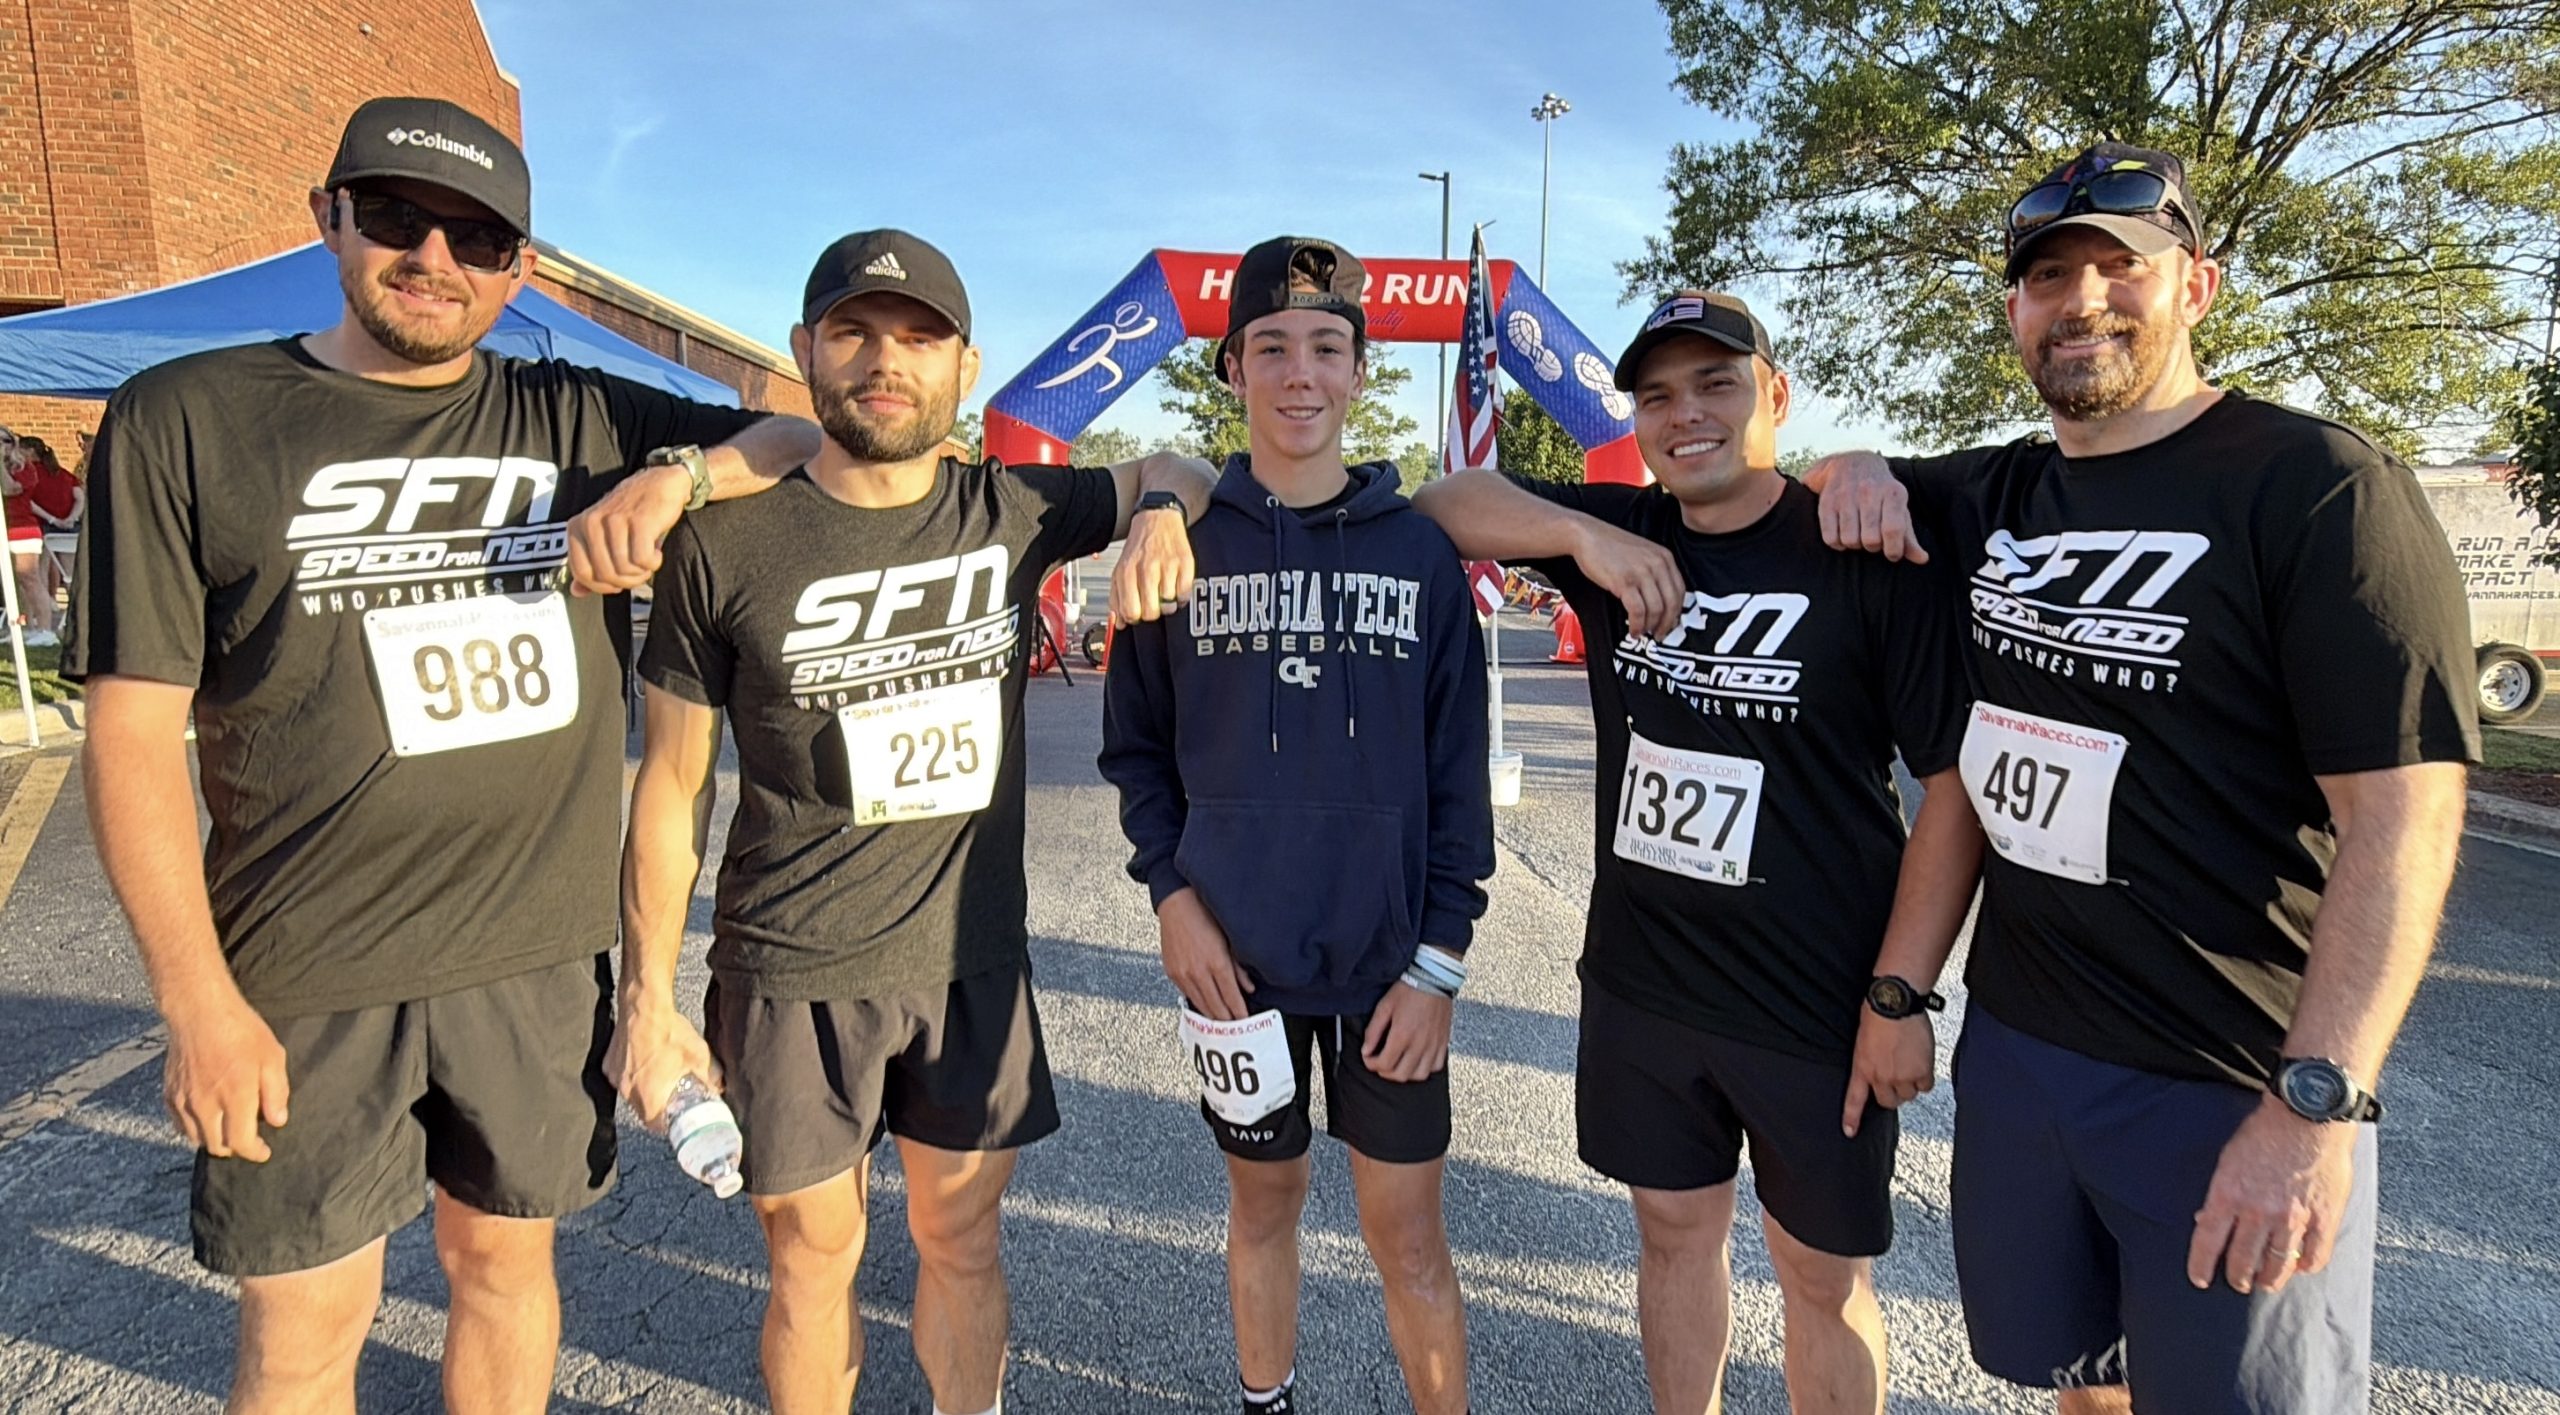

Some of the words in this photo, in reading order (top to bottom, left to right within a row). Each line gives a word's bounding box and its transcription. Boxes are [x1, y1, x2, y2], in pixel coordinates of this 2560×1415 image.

[408, 129, 493, 171] Columbia
[865, 265, 906, 280] adidas
[1381, 273, 1470, 306] RUN
[286, 457, 558, 539] SFN
[297, 543, 447, 579] SPEED
[444, 551, 485, 567] FOR
[482, 530, 569, 564] NEED
[2456, 536, 2503, 551] RUN
[2514, 537, 2530, 551] A
[302, 591, 366, 616] WHO
[389, 577, 505, 607] PUSHES
[781, 544, 1009, 654] SFN
[1190, 570, 1324, 638] GEORGIA
[1332, 572, 1420, 643] TECH
[1970, 588, 2039, 631] SPEED
[2038, 622, 2062, 638] FOR
[2061, 617, 2186, 653] NEED
[790, 643, 917, 686] SPEED
[914, 647, 947, 665] FOR
[946, 612, 1020, 658] NEED
[1197, 634, 1409, 659] BASEBALL
[1997, 637, 2076, 678] PUSHES
[2092, 662, 2179, 694] WHO?
[413, 633, 550, 721] 988
[794, 691, 848, 711] WHO
[868, 667, 964, 702] PUSHES
[1613, 657, 1648, 685] WHO
[1735, 702, 1799, 724] WHO?
[1689, 671, 1709, 686] FOR
[1709, 665, 1801, 692] NEED
[890, 720, 979, 789] 225
[1979, 707, 2109, 753] SavannahRaces.com
[1622, 764, 1748, 853] 1327
[1983, 750, 2071, 830] 497
[1193, 1042, 1260, 1096] 496
